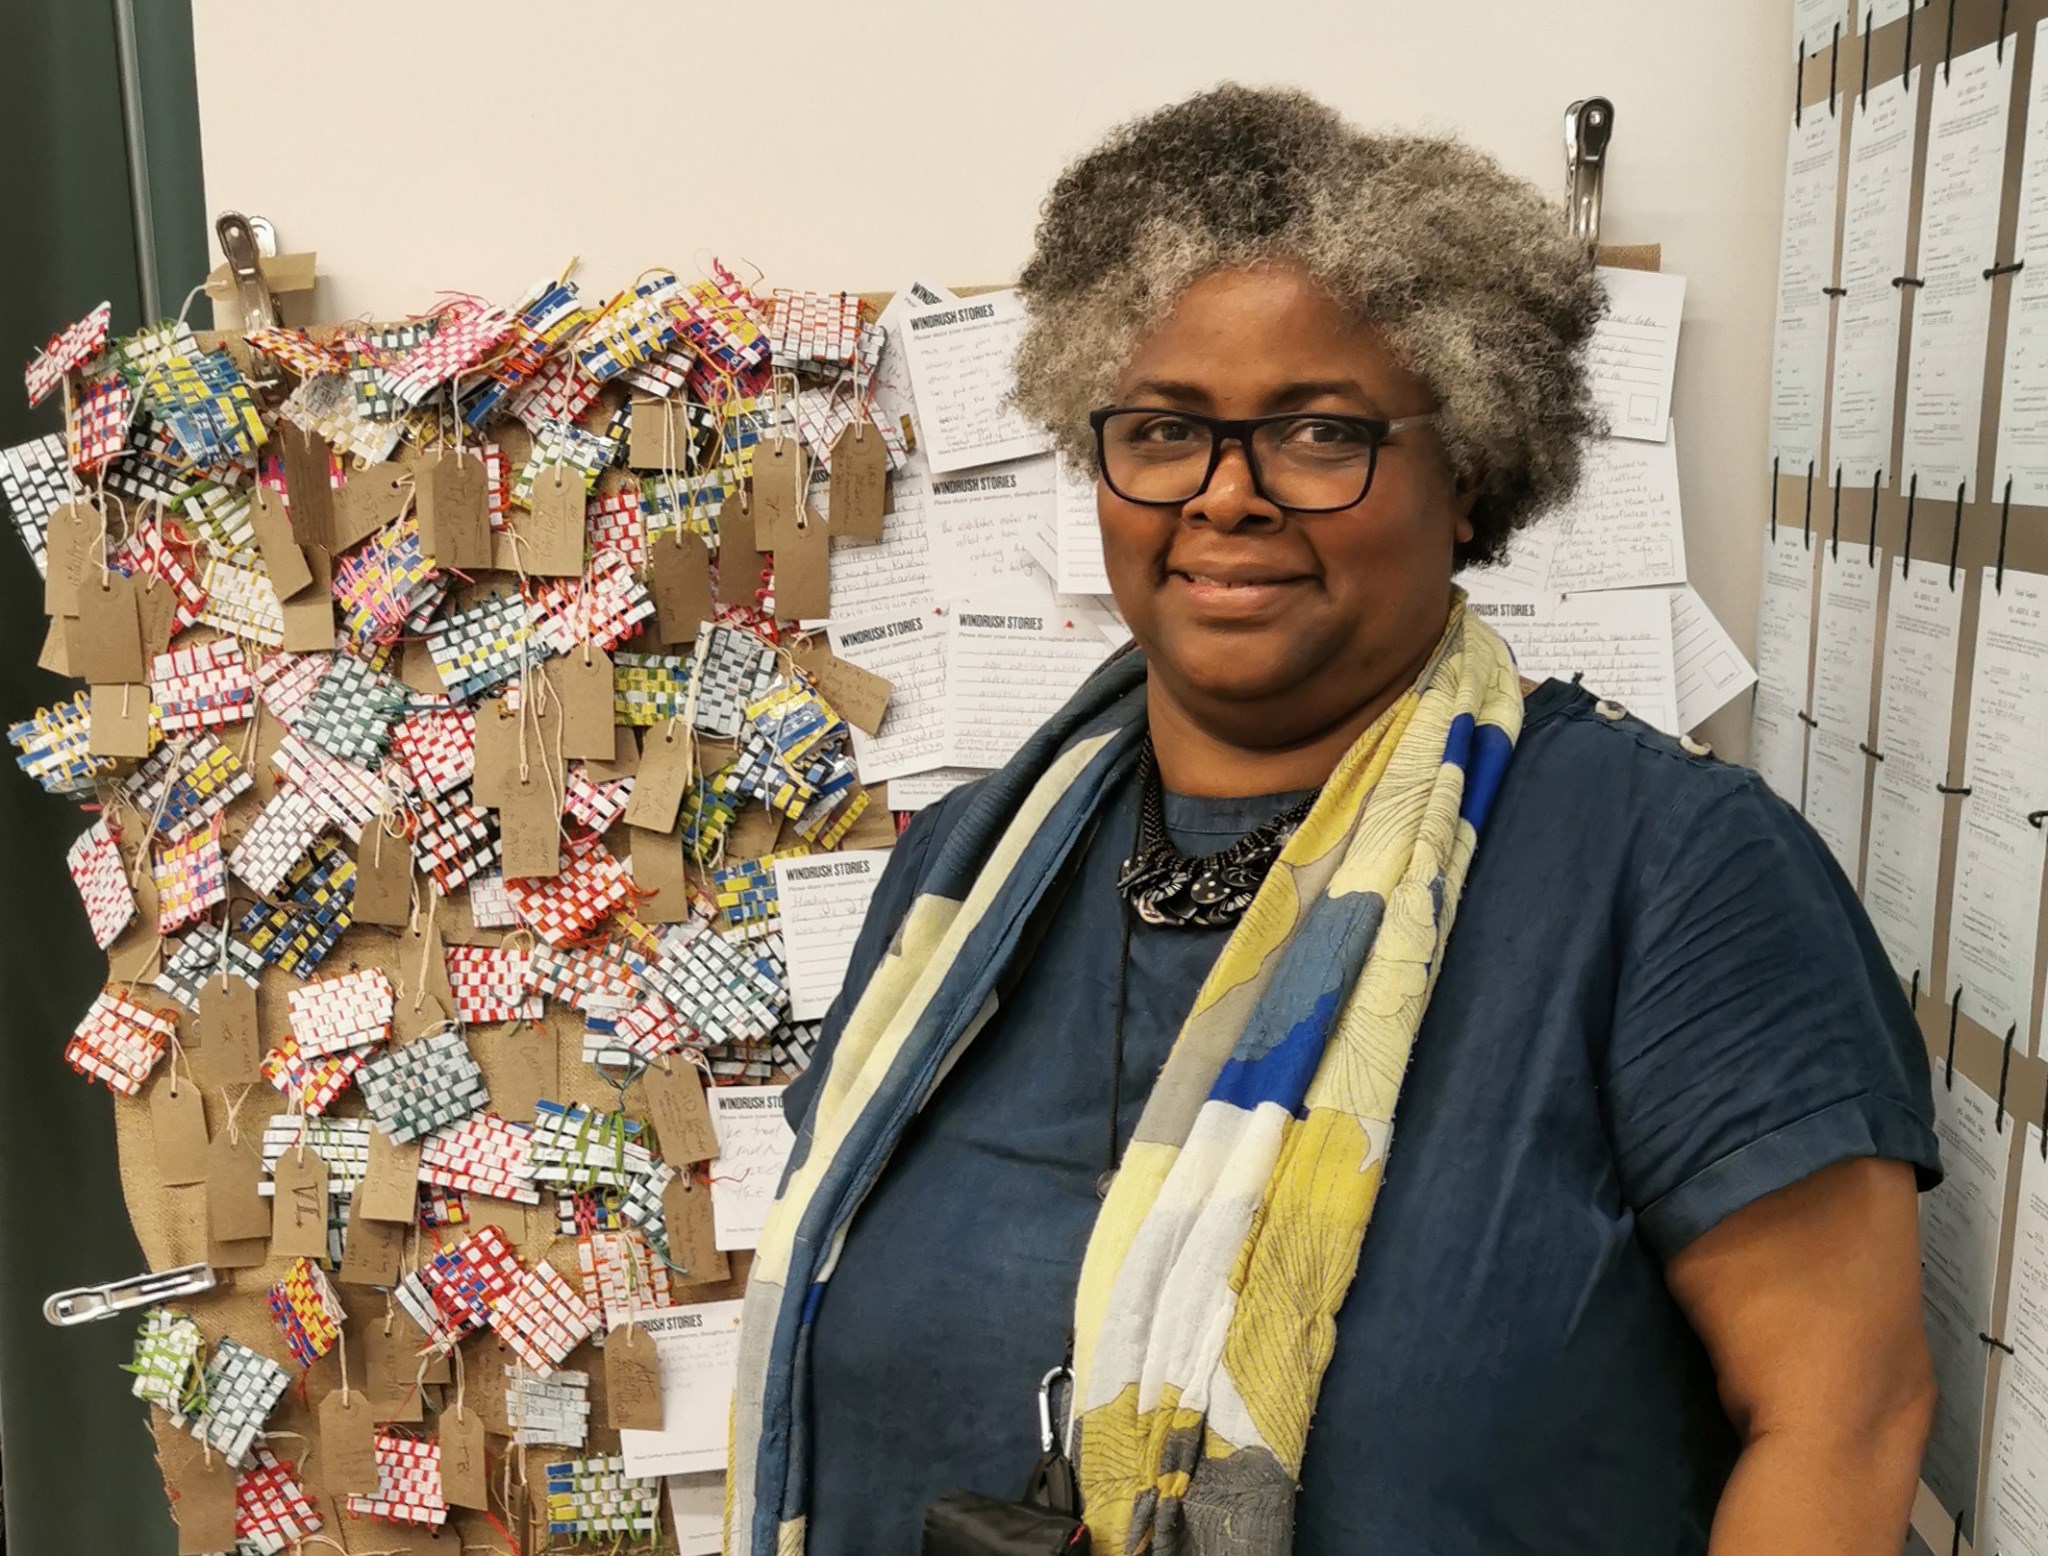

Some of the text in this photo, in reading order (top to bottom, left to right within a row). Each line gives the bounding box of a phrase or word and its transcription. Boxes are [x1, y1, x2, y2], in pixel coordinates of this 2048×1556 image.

[911, 281, 943, 305] WINDR
[910, 304, 994, 331] WINDRUSH STORIES
[932, 474, 1017, 495] WINDRUSH STORIES
[1467, 604, 1535, 616] DRUSH STORIES
[839, 617, 923, 648] WINDRUSH STORIES
[959, 614, 1043, 630] WINDRUSH STORIES
[786, 860, 870, 881] WINDRUSH STORIES
[718, 1096, 766, 1110] WINDRUSH
[666, 1314, 703, 1330] STORIES
